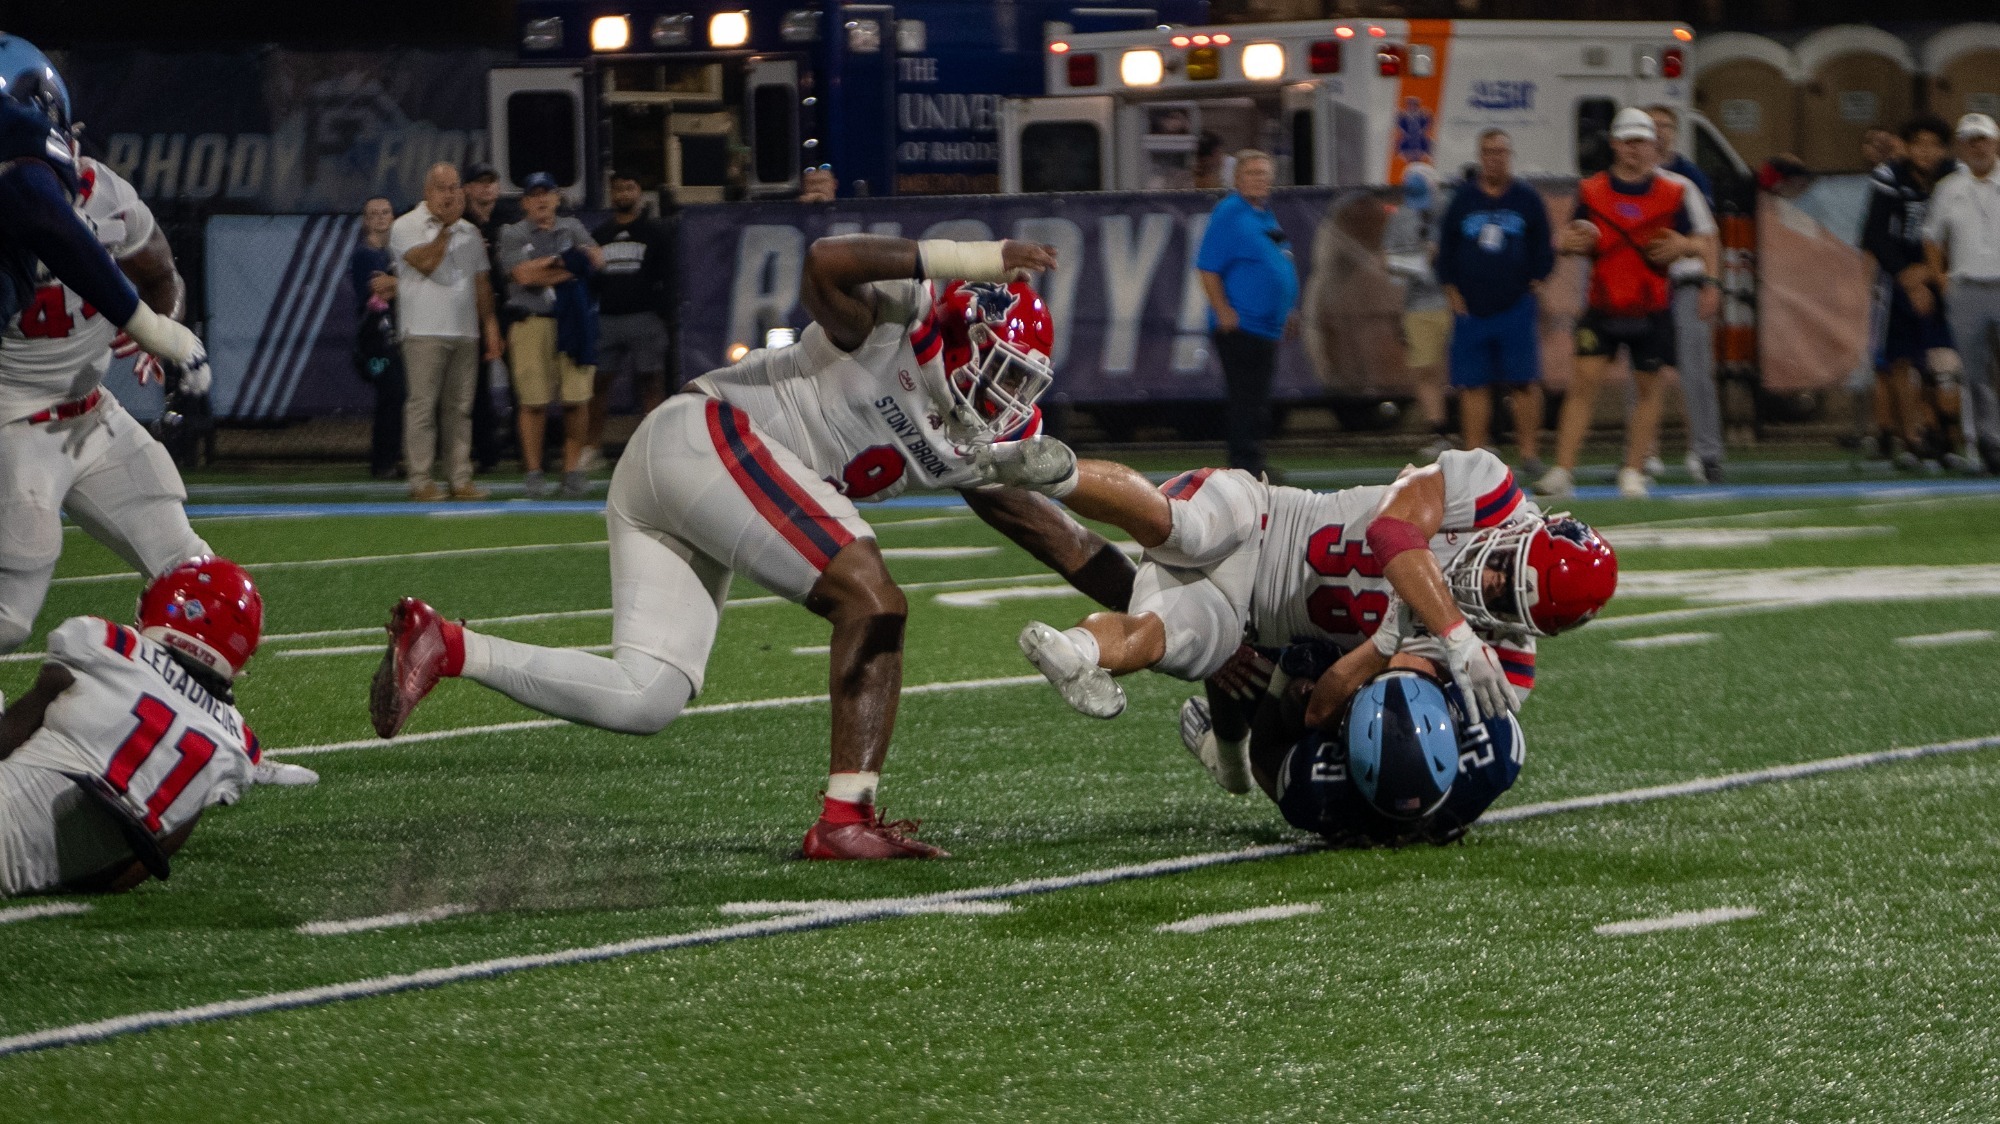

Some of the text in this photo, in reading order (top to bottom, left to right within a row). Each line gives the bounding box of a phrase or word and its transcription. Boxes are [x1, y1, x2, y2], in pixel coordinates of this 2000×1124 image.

[898, 57, 938, 81] THE
[898, 93, 1003, 131] UNIVE
[900, 141, 927, 162] OF
[727, 213, 1213, 373] RDY!
[823, 442, 908, 499] 9
[874, 395, 954, 479] STONY BROOK
[1305, 523, 1390, 639] 38
[104, 691, 218, 834] 11
